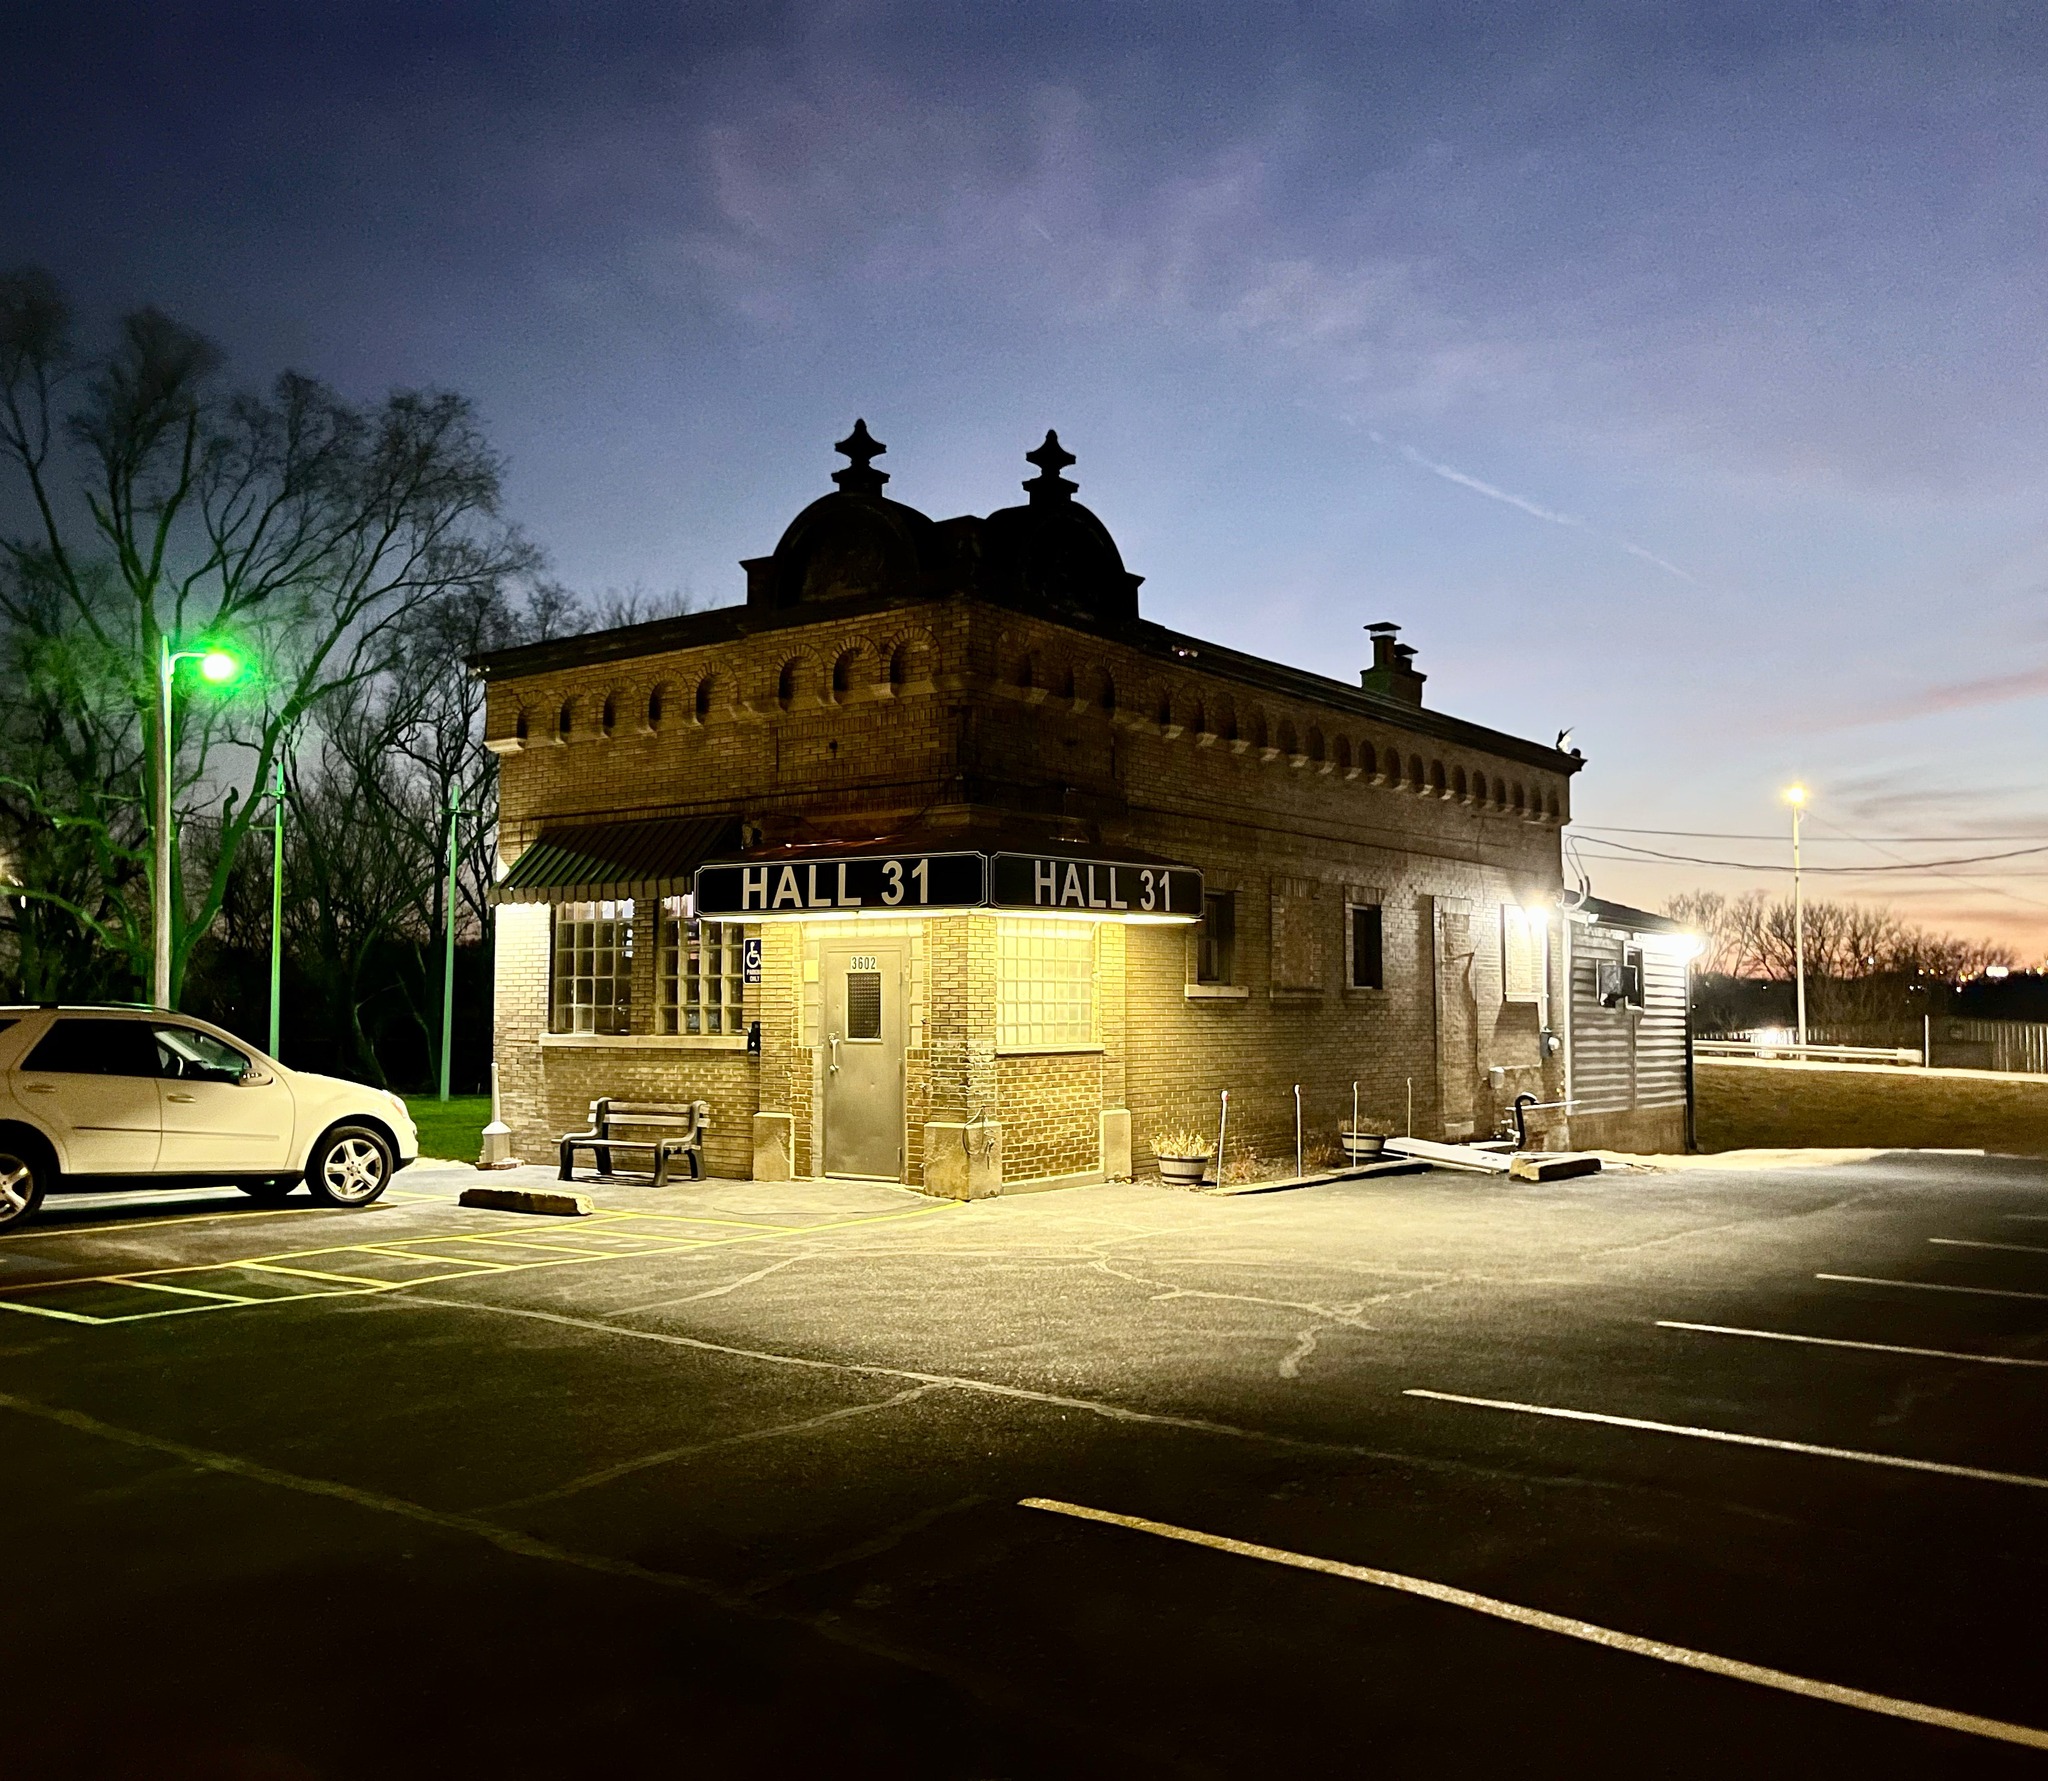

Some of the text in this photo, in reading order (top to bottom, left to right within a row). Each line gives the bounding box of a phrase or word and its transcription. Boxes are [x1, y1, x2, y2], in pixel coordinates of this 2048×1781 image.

[742, 858, 929, 910] HALL 31
[1034, 860, 1171, 912] HALL 31
[851, 956, 876, 970] 3602
